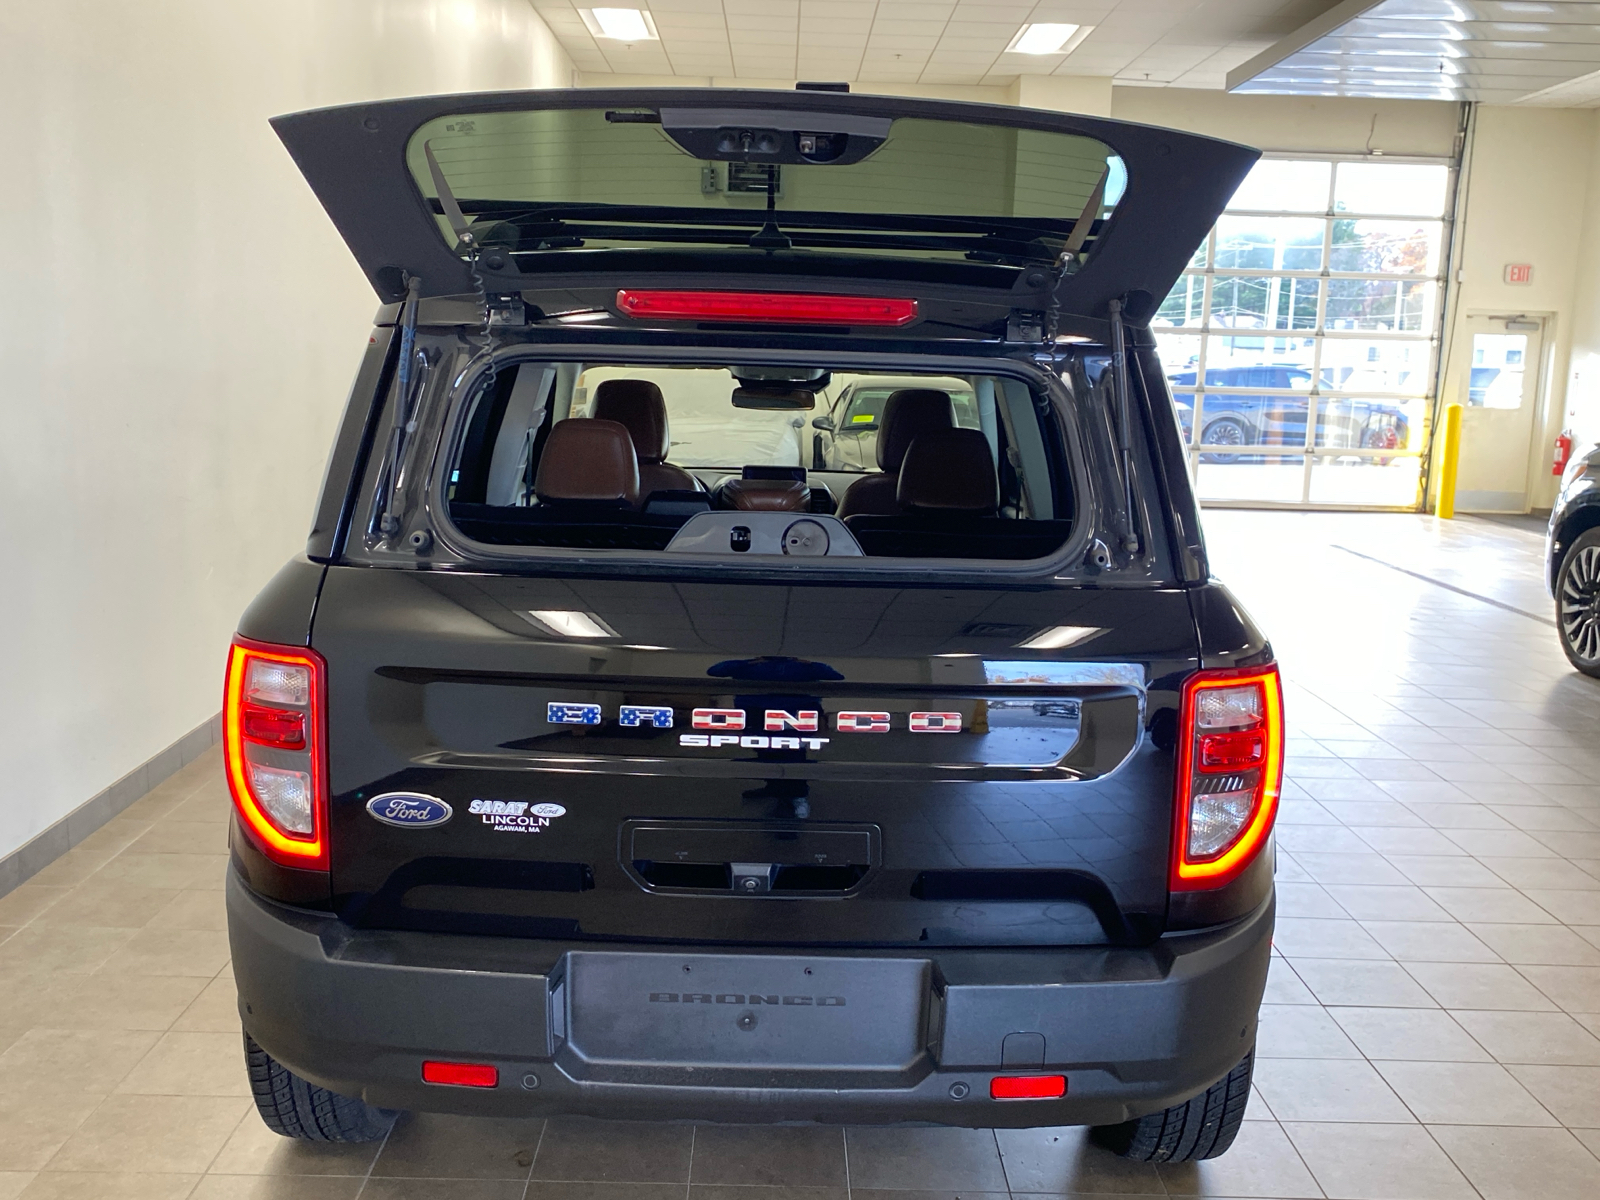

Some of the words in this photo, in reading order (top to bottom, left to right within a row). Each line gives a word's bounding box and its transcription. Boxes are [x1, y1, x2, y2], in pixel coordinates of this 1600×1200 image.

[1510, 266, 1531, 282] EXIT
[547, 702, 962, 733] BRONCO
[679, 734, 830, 750] SPORT
[386, 799, 431, 820] Ford
[468, 800, 528, 815] SARAT
[482, 815, 549, 826] LINCOLN
[650, 993, 846, 1006] BRONCO
